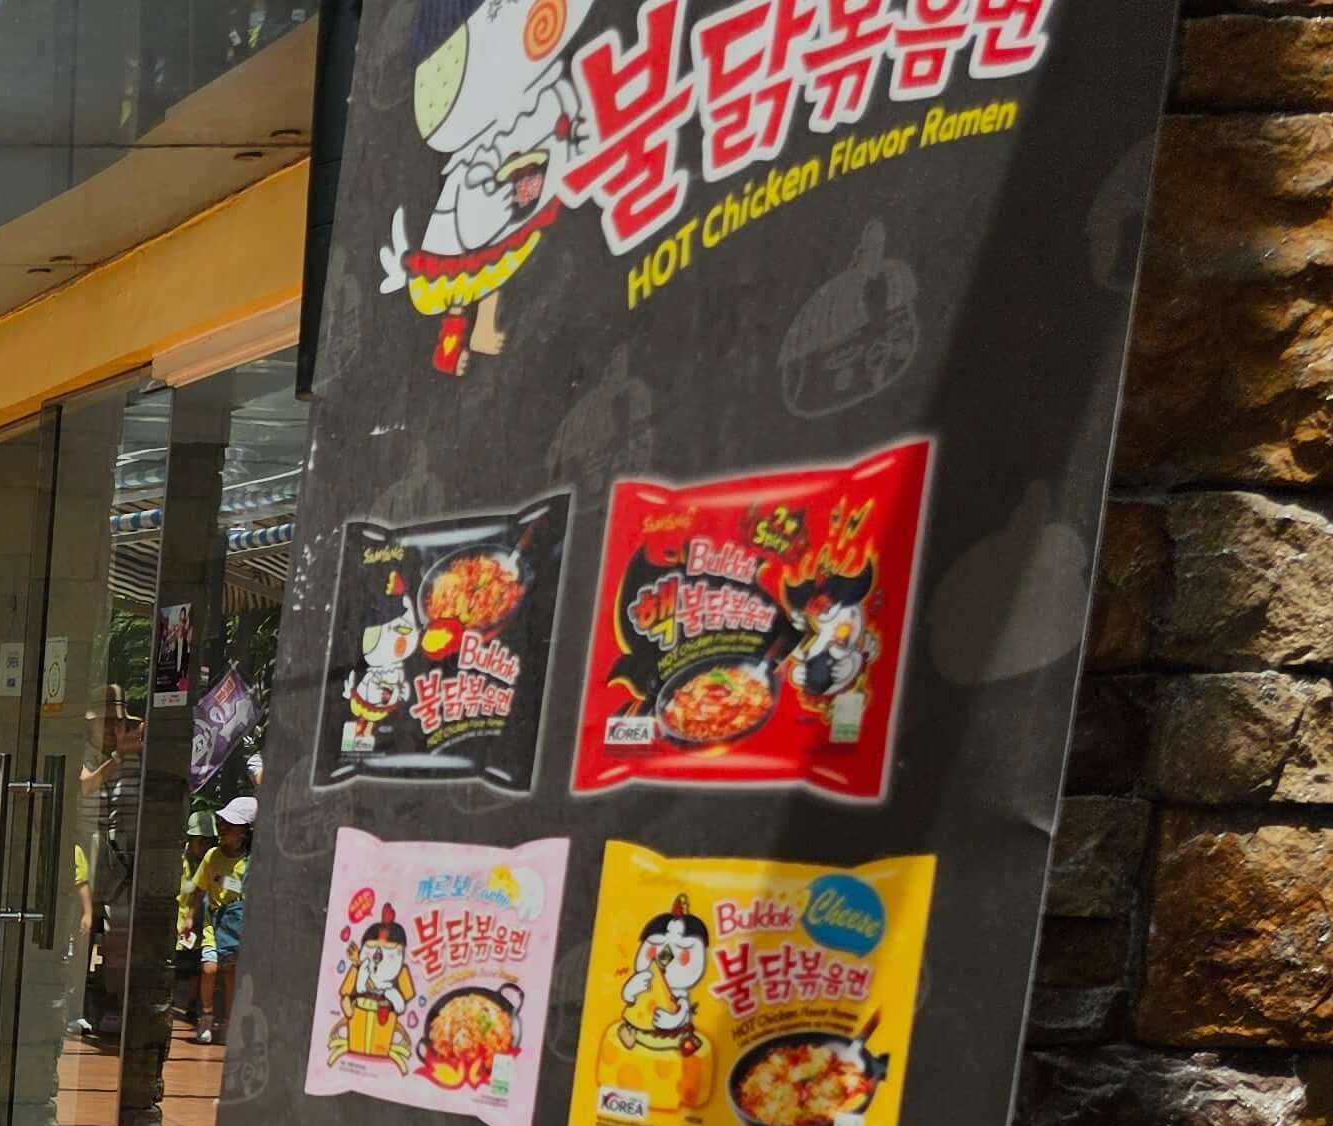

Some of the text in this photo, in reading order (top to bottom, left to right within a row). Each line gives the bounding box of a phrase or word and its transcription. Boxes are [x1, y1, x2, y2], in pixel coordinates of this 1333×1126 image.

[561, 0, 1045, 250] 불닭볶음면
[628, 100, 1018, 310] HOT Chicken Flavor Ramen
[686, 538, 757, 584] Buldak
[458, 630, 520, 685] Buldak
[409, 669, 514, 734] 불닭볶음면
[714, 899, 794, 937] Buldak
[807, 888, 882, 939] Cheese
[410, 909, 531, 980] 불닭볶음면
[709, 942, 871, 1017] 불닭볶음면
[602, 1091, 643, 1116] KOREA
